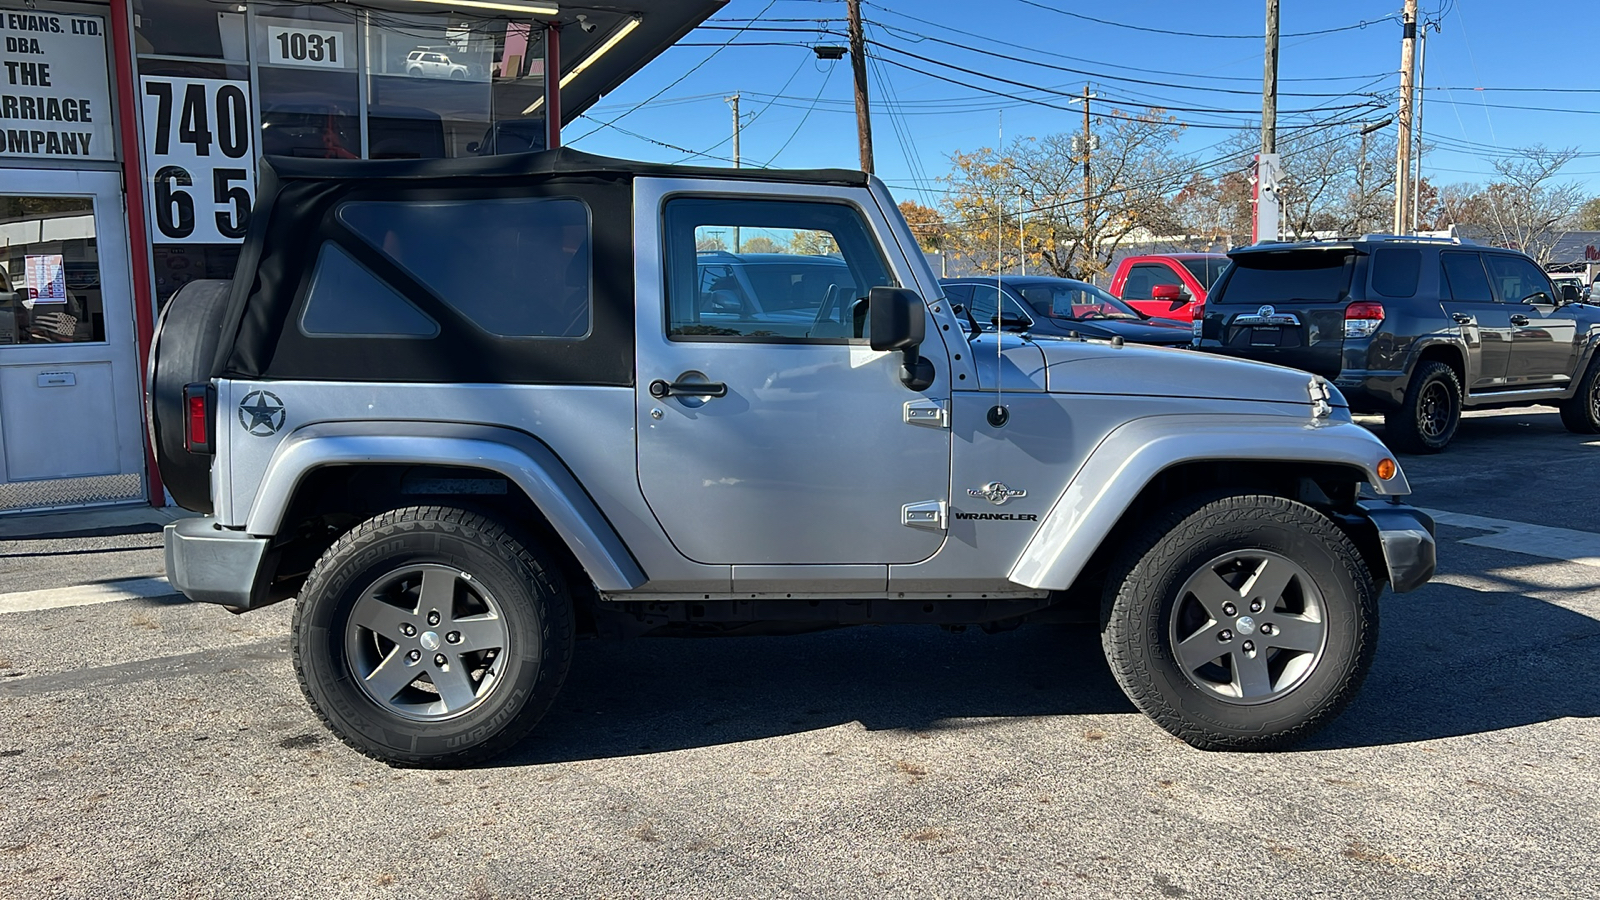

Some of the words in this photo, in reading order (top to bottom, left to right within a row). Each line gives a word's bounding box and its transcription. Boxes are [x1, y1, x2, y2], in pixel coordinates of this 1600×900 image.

[8, 14, 64, 33] EVANS.
[72, 19, 102, 36] LTD.
[6, 36, 44, 54] DBA.
[276, 32, 338, 63] 1031
[4, 61, 51, 87] THE
[0, 95, 92, 122] RRIAGE
[145, 81, 249, 158] 740
[955, 513, 1037, 521] WRANGLER
[1303, 611, 1354, 710] NEXEN
